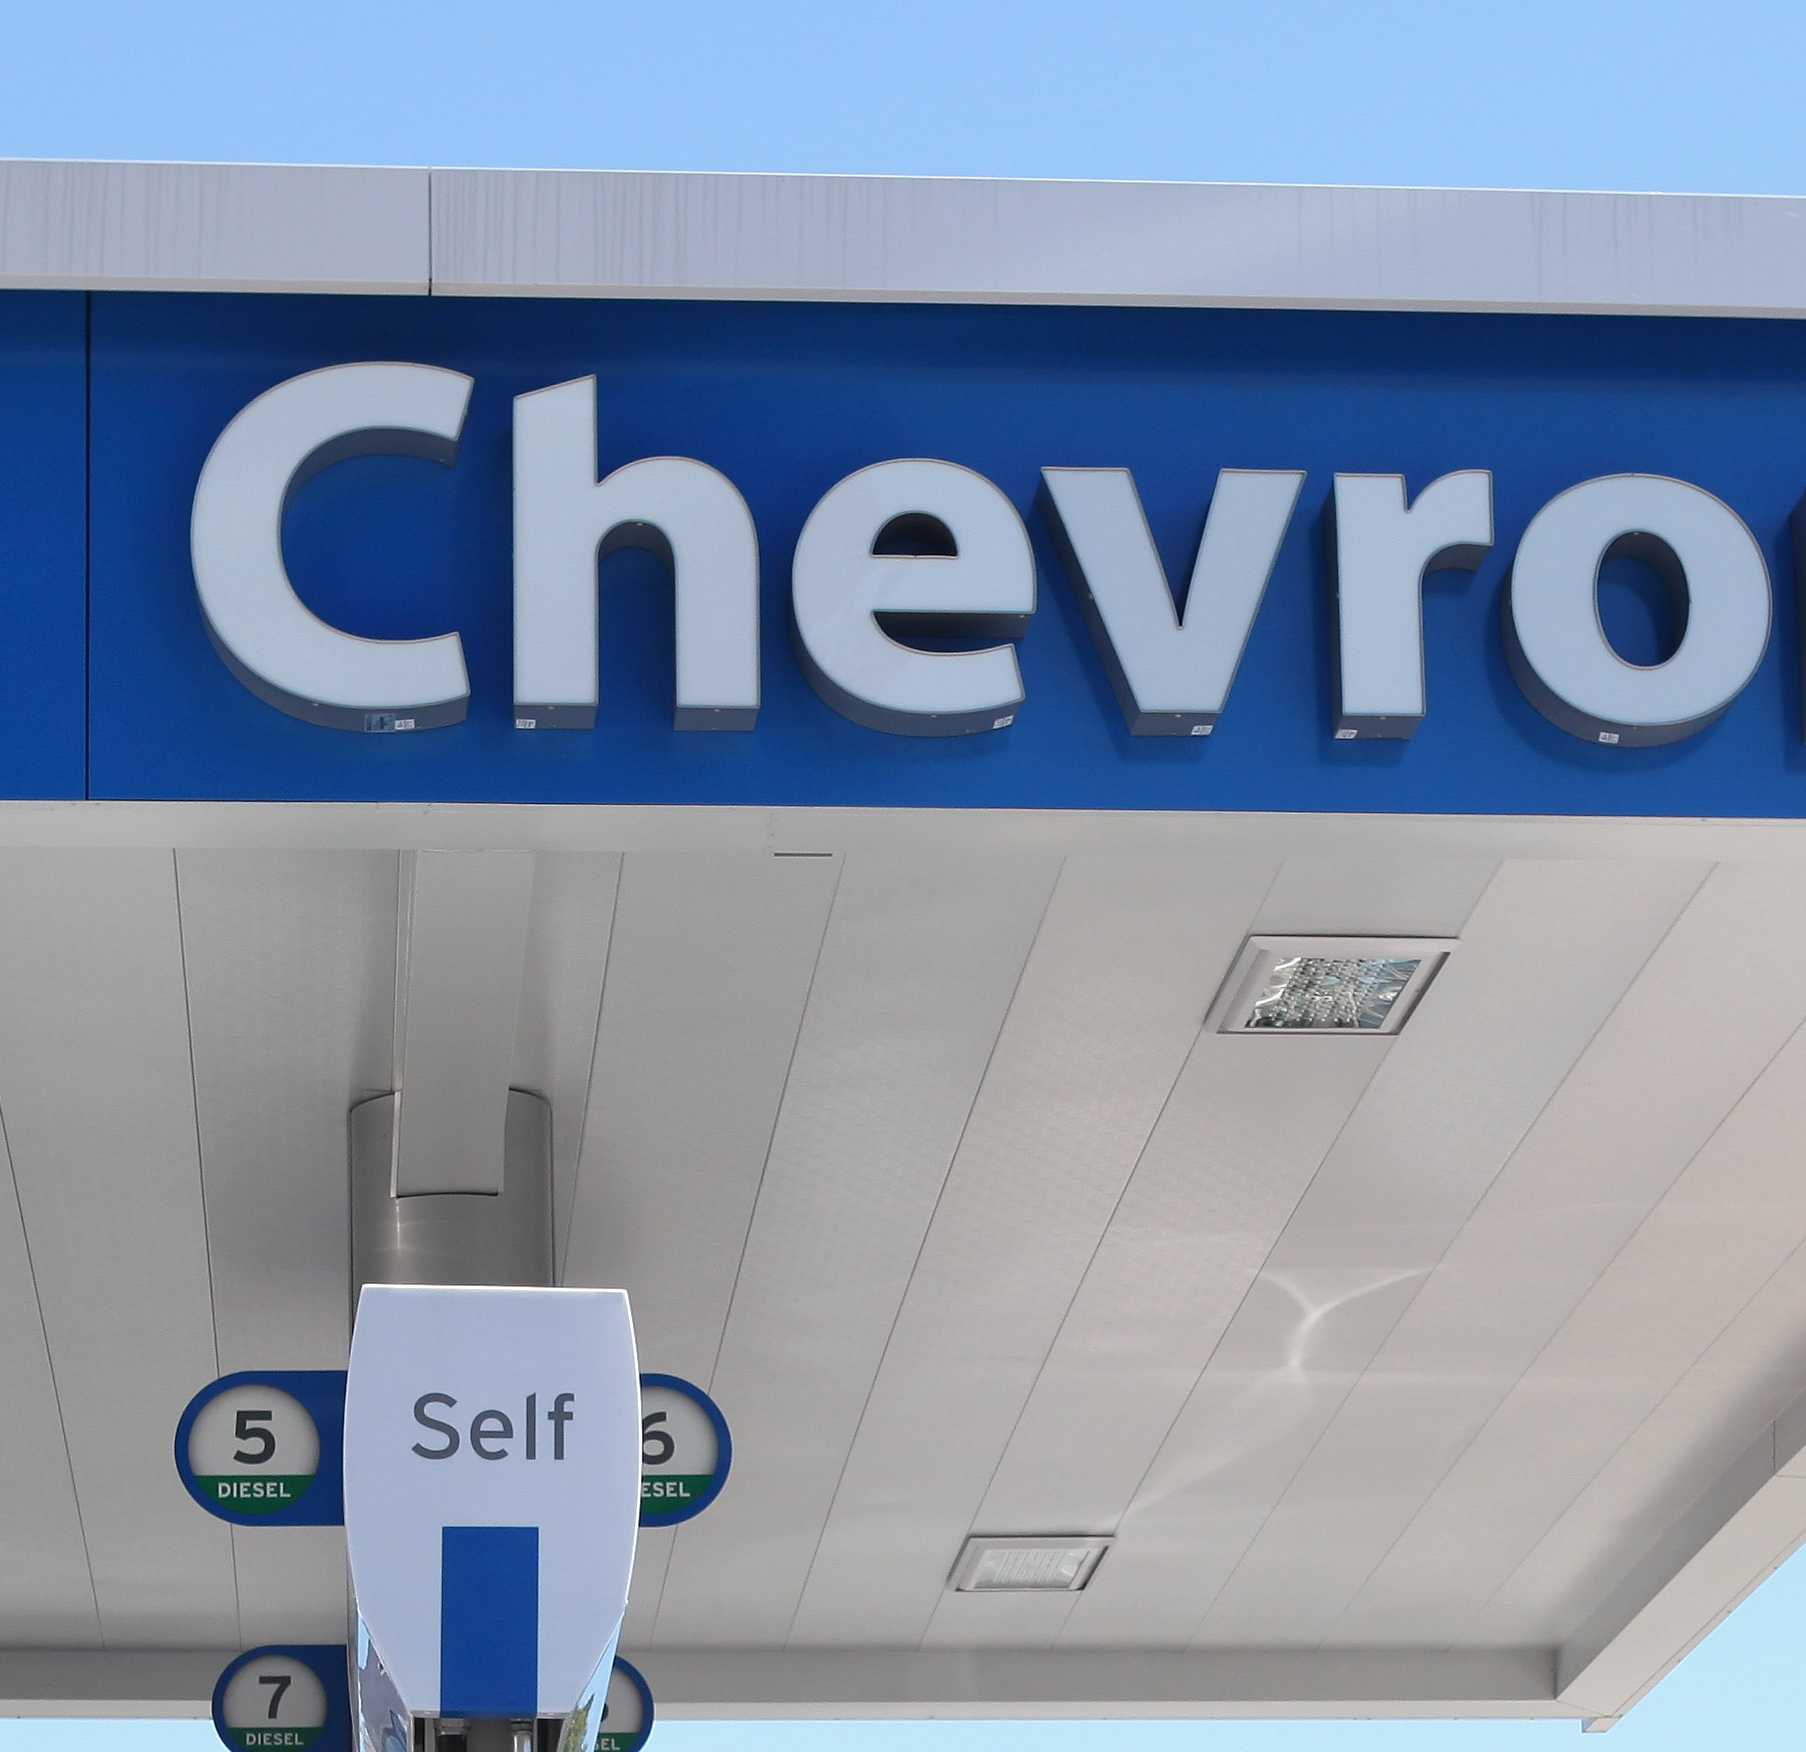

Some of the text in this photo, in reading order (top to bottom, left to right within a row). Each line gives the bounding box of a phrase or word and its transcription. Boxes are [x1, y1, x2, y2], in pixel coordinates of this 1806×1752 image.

[233, 1410, 276, 1465] 5
[412, 1392, 575, 1461] Self
[642, 1410, 675, 1465] 6
[217, 1481, 291, 1498] DIESEL
[642, 1481, 691, 1498] ESEL
[258, 1675, 292, 1720] 7
[245, 1732, 305, 1746] DIESEL
